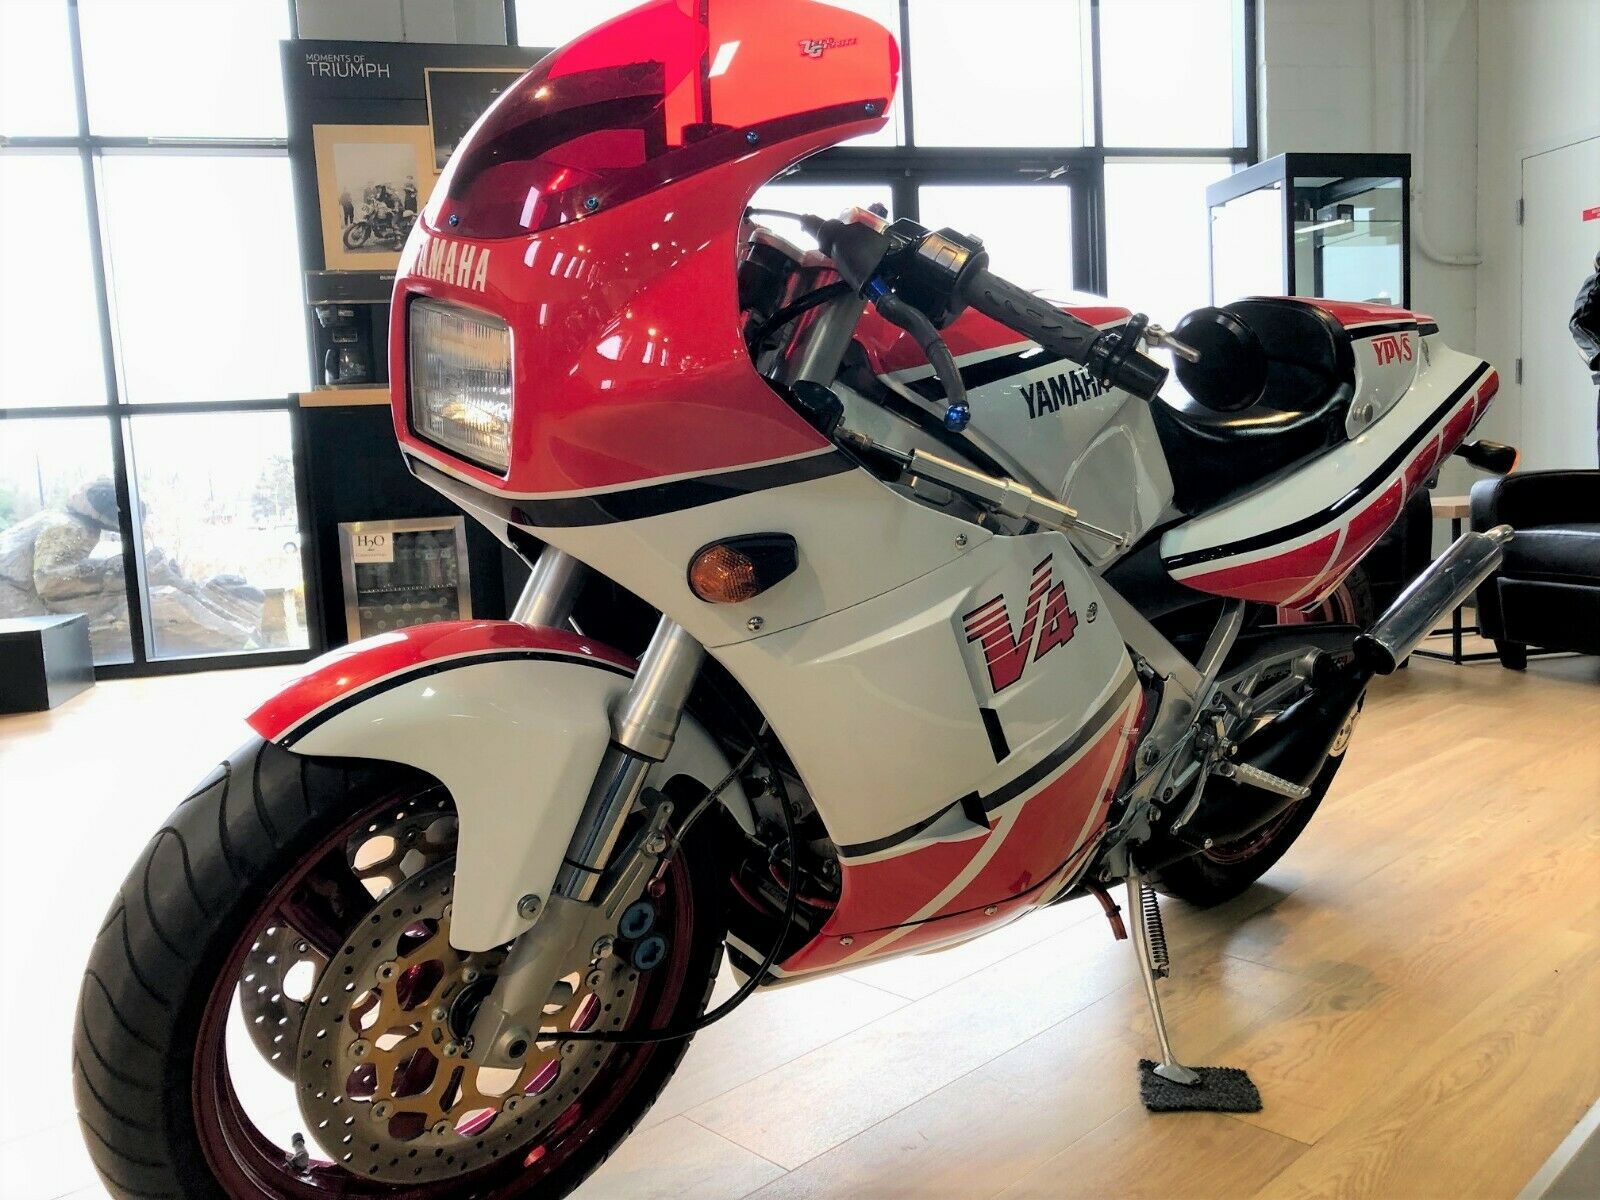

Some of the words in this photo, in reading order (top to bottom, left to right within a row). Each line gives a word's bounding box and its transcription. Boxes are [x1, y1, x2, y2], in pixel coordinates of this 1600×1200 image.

[305, 53, 351, 63] MOMENTS
[353, 55, 366, 63] OF
[306, 61, 390, 78] TRIUMPH
[1371, 333, 1412, 366] YPVS
[962, 552, 1079, 694] V4
